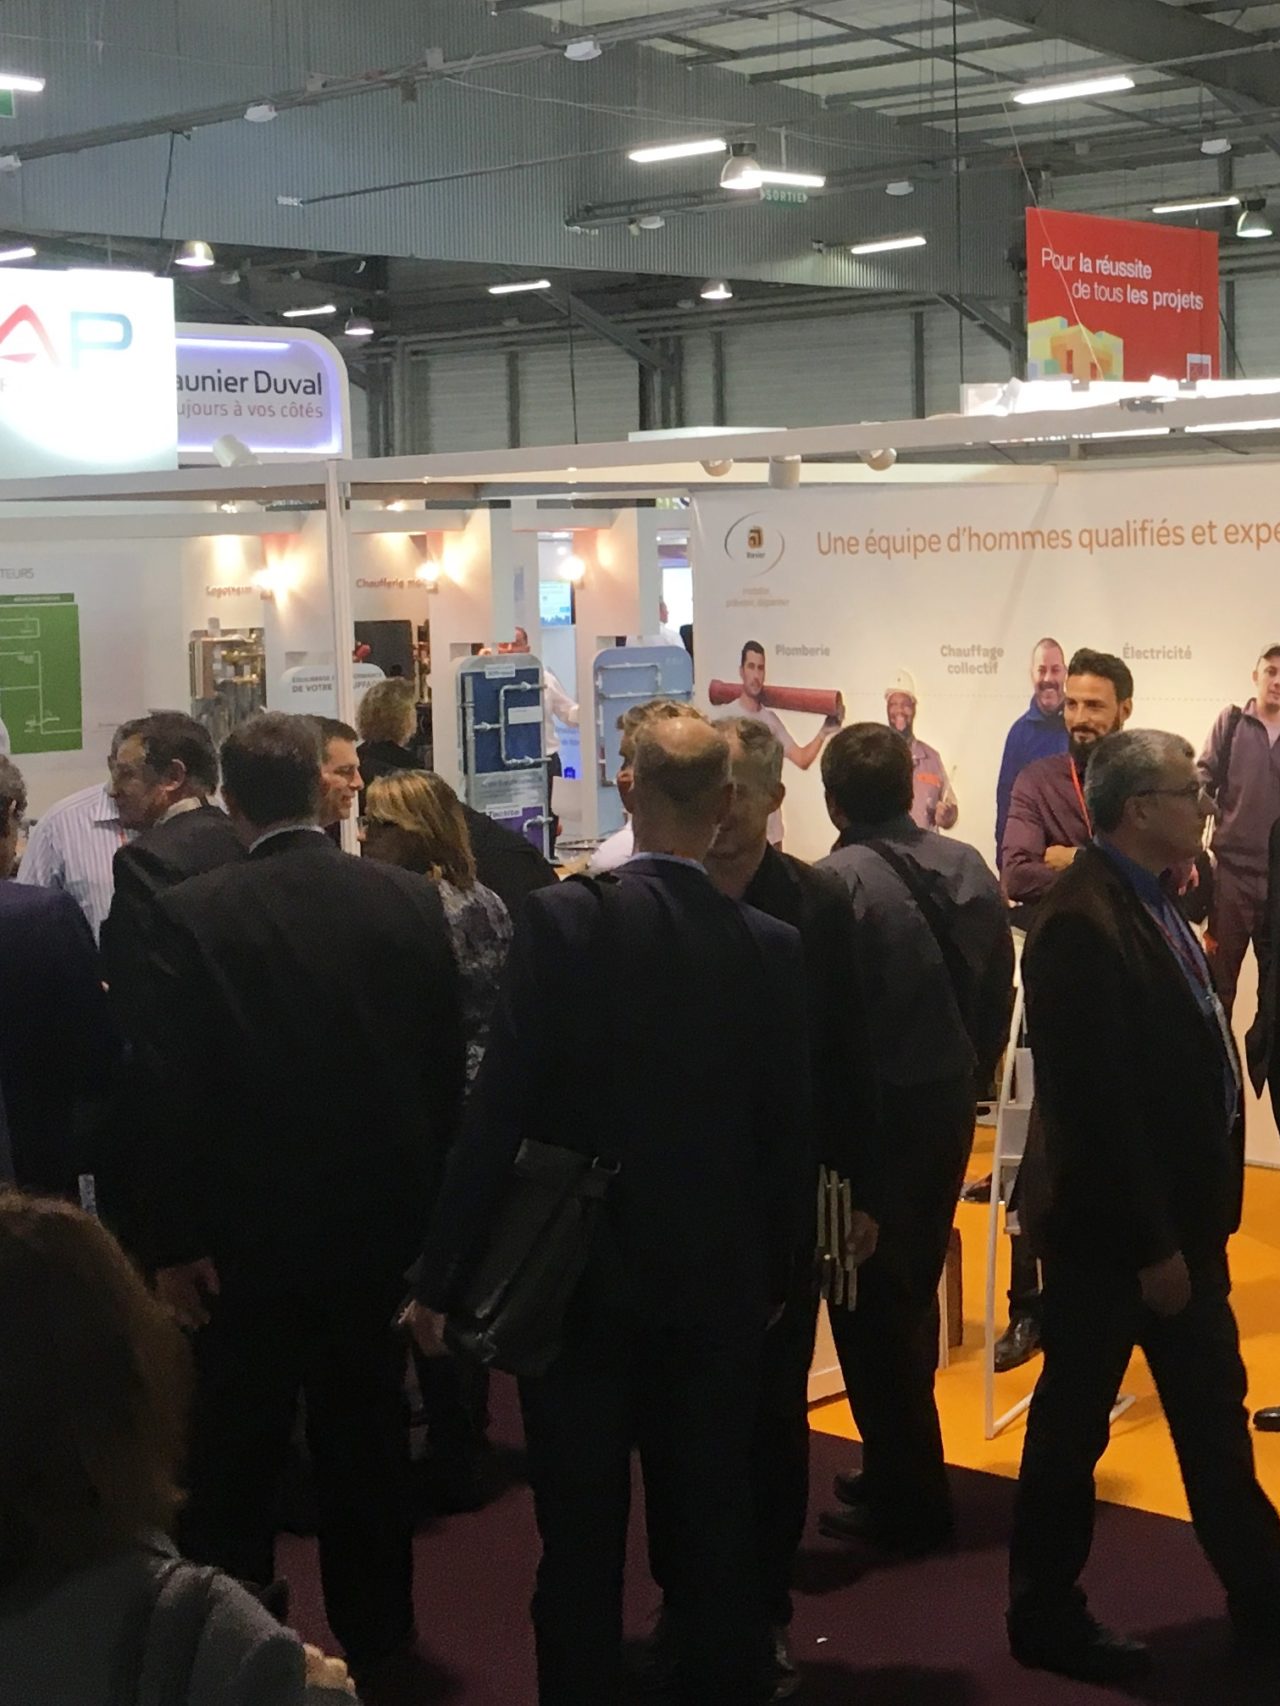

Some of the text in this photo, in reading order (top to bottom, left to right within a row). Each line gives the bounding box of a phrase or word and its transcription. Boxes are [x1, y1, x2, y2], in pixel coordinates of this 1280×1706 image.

[766, 189, 803, 203] SORTIE
[1042, 247, 1153, 280] Pour la réussite
[1072, 279, 1204, 313] de tous les projets
[254, 370, 322, 395] Duval
[233, 401, 243, 417] à
[248, 404, 276, 418] vos
[280, 402, 324, 418] côtés
[816, 532, 859, 555] Une
[865, 528, 941, 560] équipe
[947, 526, 1072, 552] d'hommes
[1078, 518, 1185, 554] qualifiés
[1191, 520, 1217, 545] et
[775, 644, 830, 657] Plomberie
[941, 644, 1004, 661] Chauffage
[1122, 643, 1192, 660] Électricité
[947, 662, 998, 675] collectif
